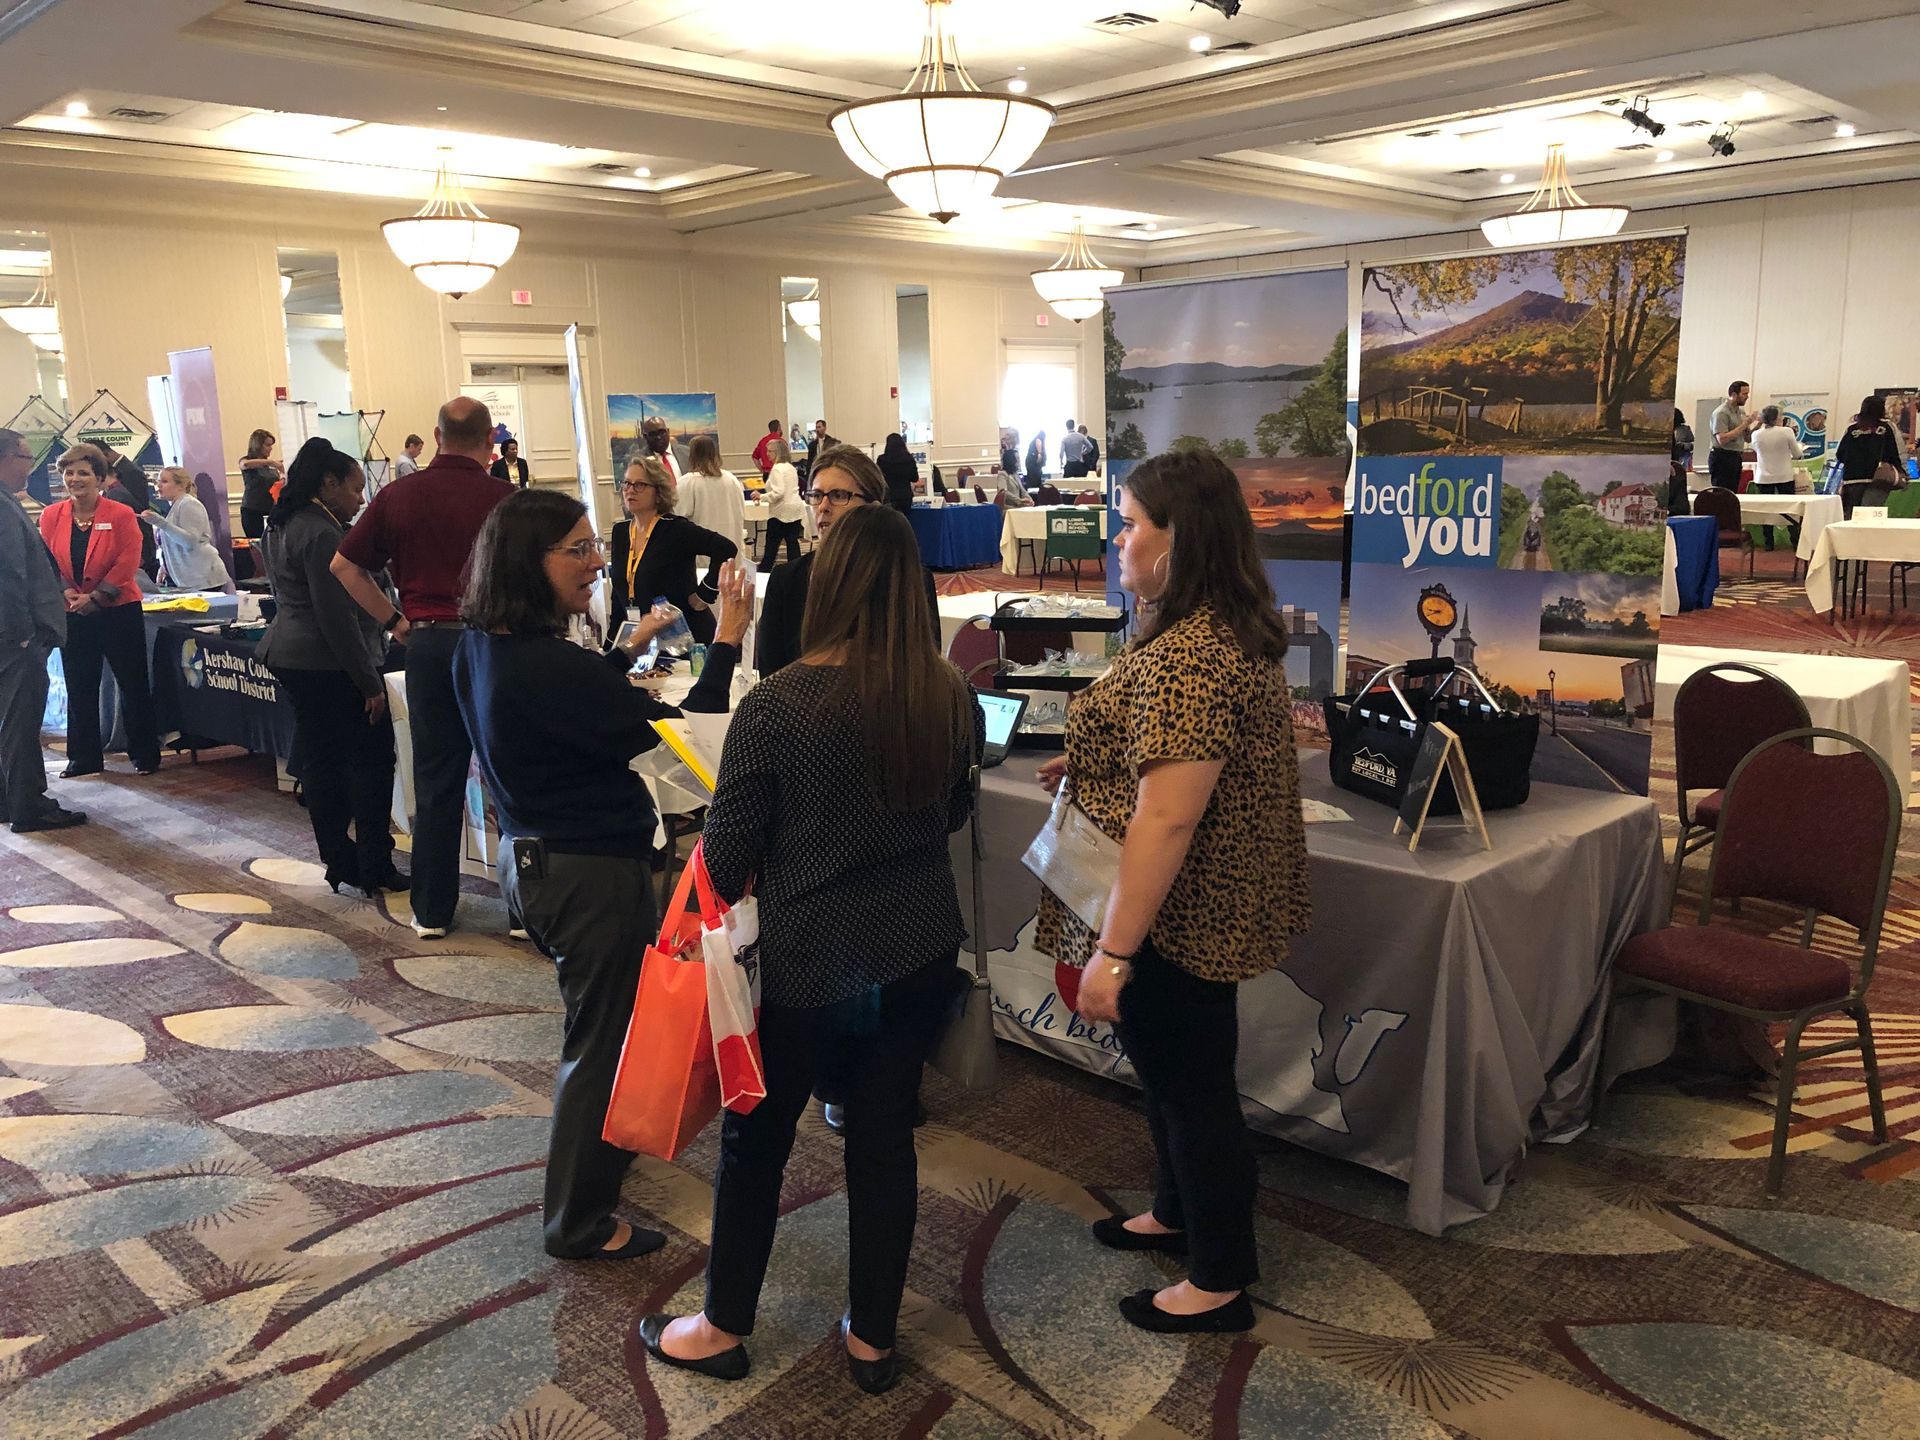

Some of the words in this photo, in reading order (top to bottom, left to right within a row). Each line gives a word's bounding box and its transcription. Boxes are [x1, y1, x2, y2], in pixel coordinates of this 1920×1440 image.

[1360, 462, 1494, 517] bedford
[1402, 516, 1492, 569] you
[203, 647, 246, 673] Kershaw
[206, 669, 238, 691] School
[240, 675, 277, 702] District
